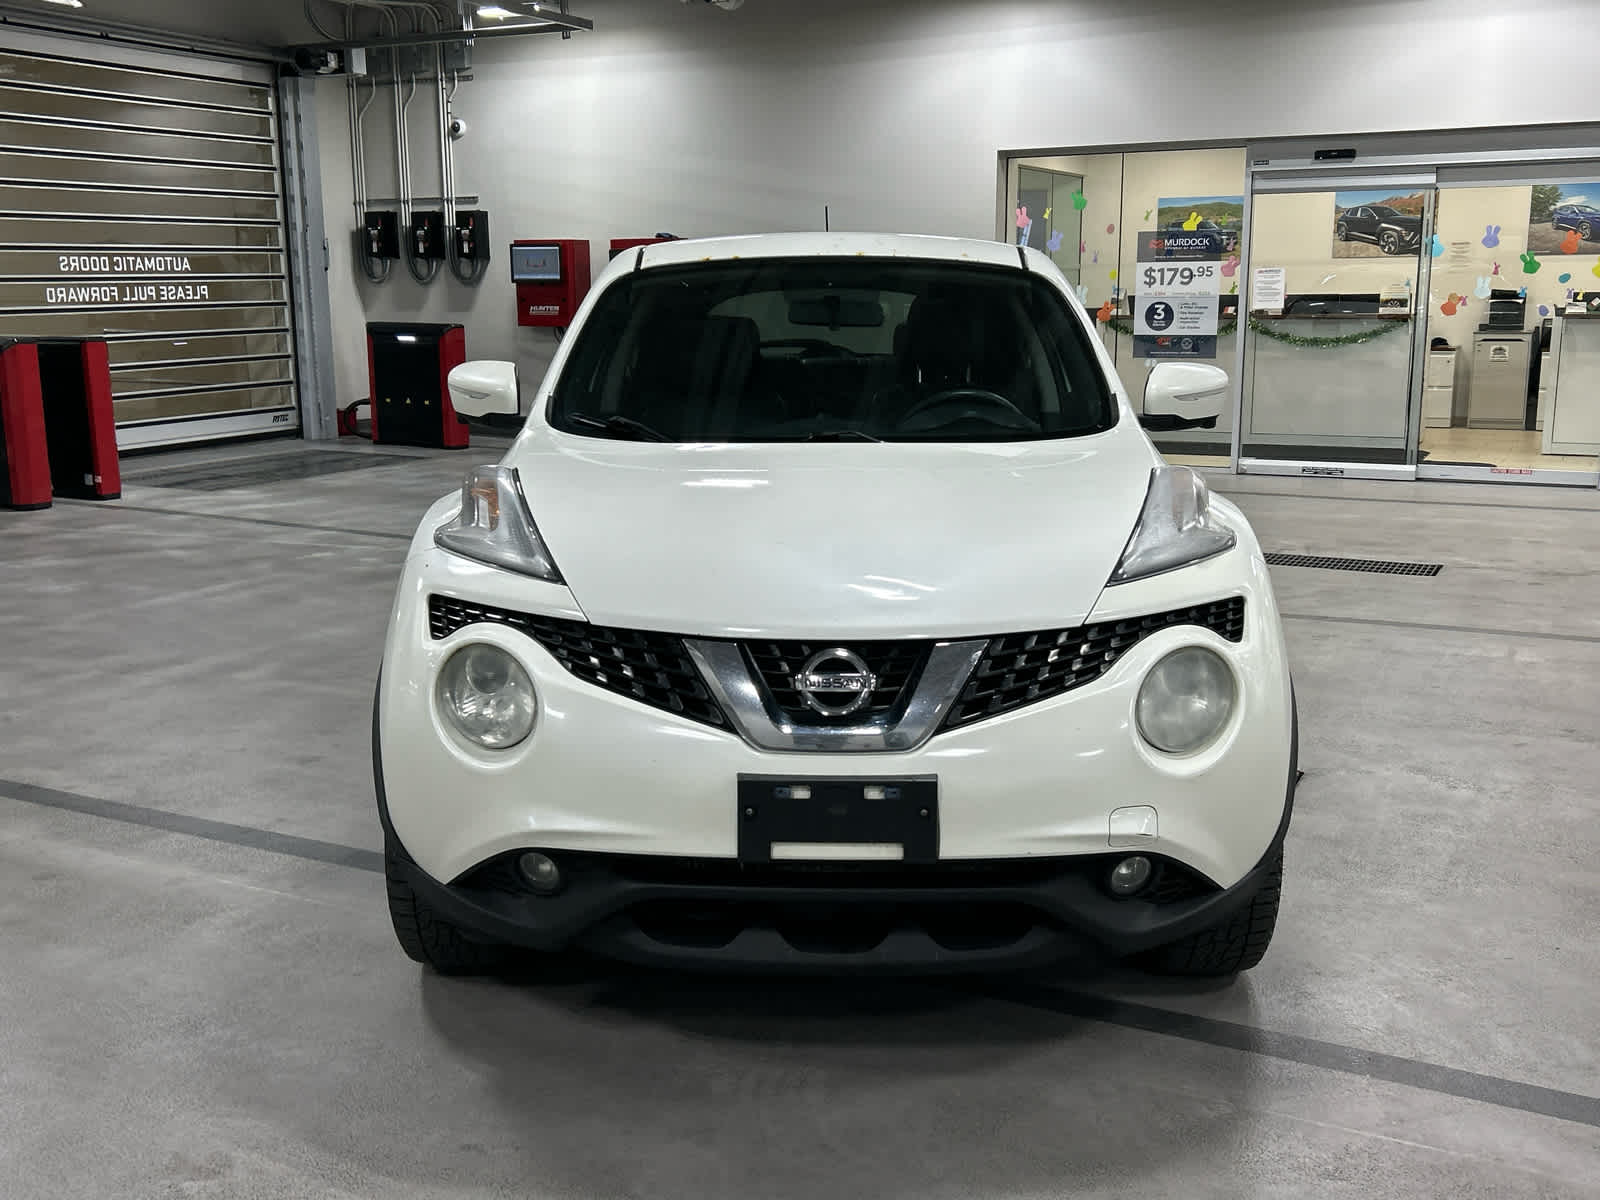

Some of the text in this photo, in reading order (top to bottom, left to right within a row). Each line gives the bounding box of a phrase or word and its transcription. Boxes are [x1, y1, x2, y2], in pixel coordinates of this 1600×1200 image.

[1164, 238, 1210, 247] MURDOCK
[1144, 266, 1213, 288] $179.95
[1153, 304, 1166, 319] 3
